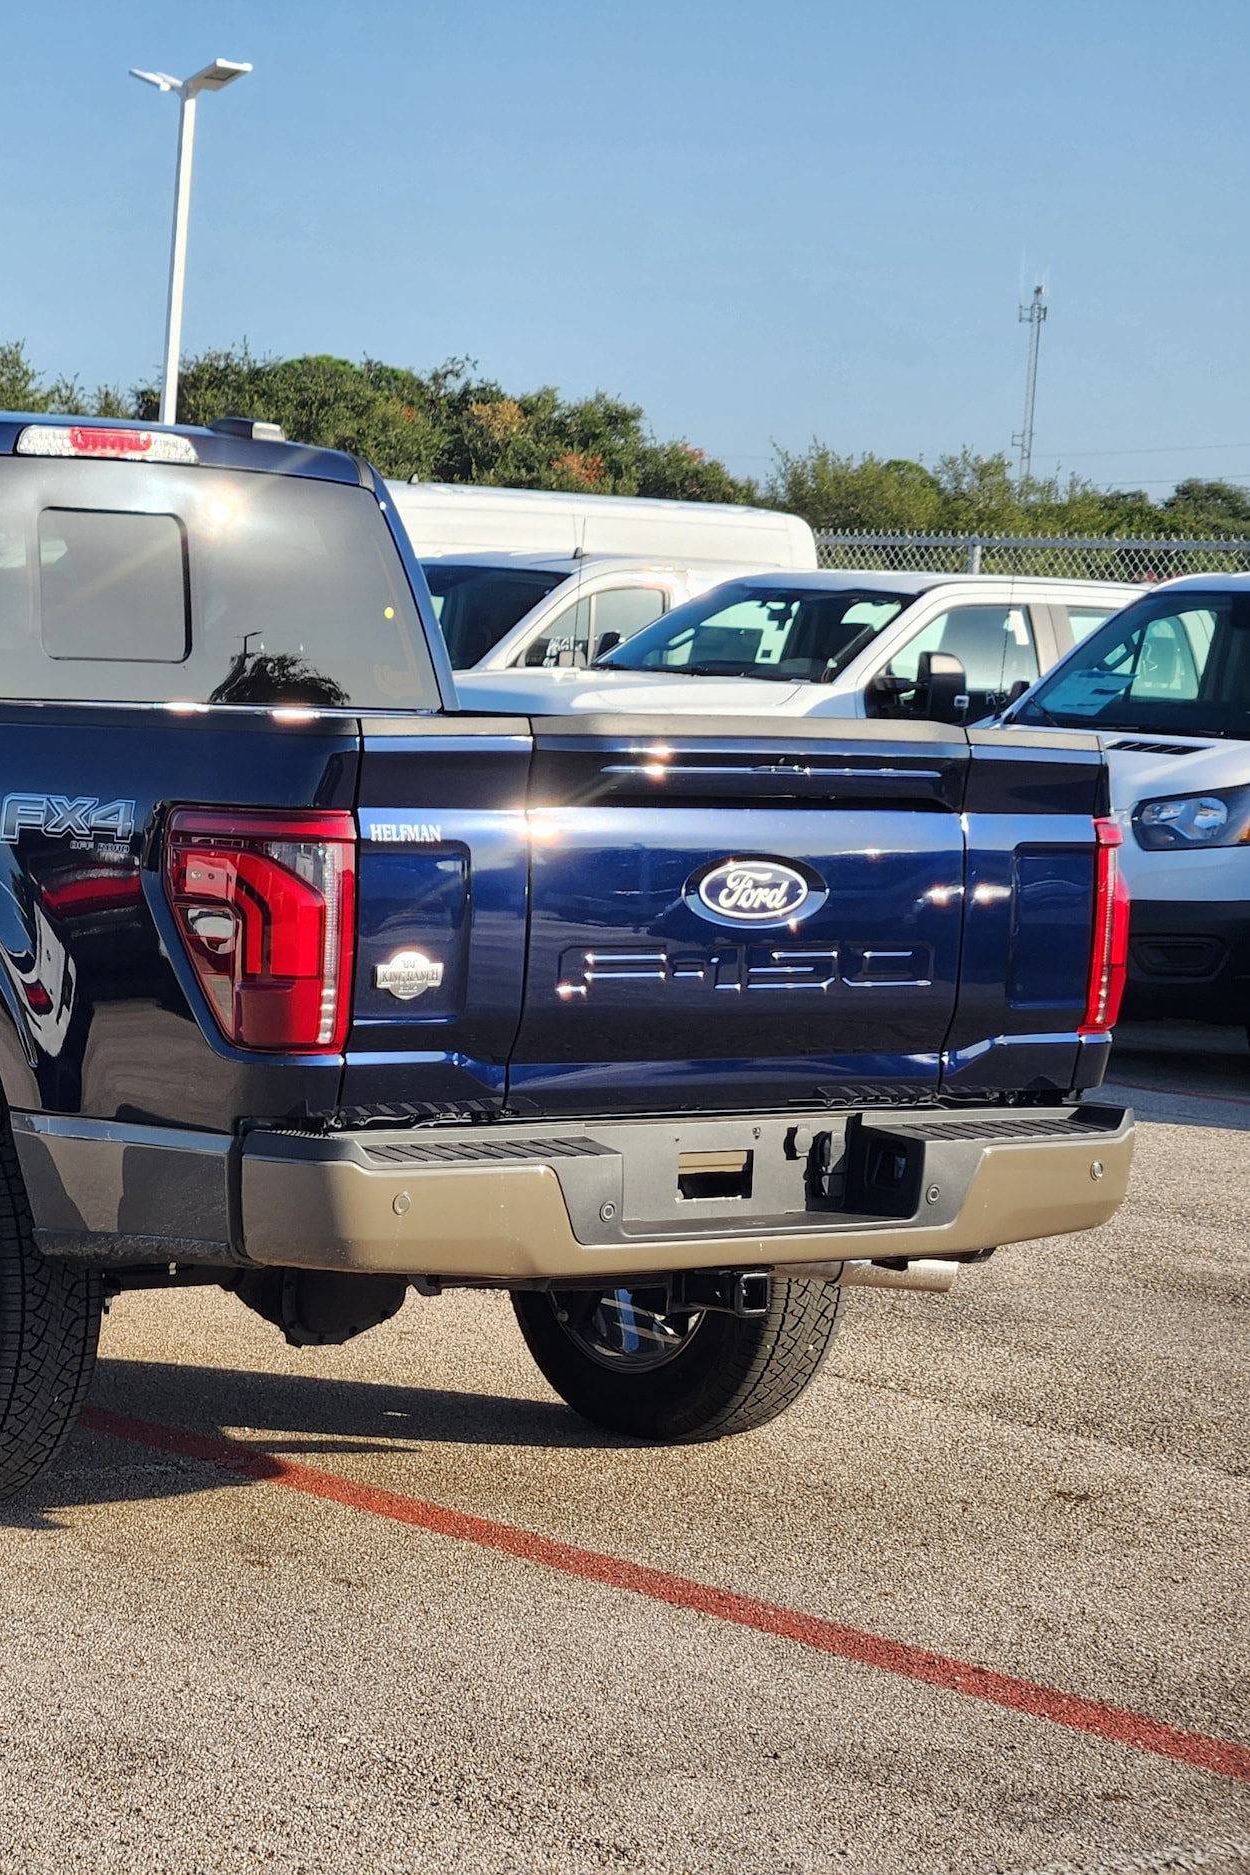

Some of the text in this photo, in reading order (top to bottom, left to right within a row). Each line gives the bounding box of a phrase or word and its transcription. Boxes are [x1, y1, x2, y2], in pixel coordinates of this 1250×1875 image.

[0, 792, 136, 845] FX4
[369, 823, 442, 843] HELFMAN
[717, 869, 788, 910] Ford
[556, 941, 935, 995] F-150
